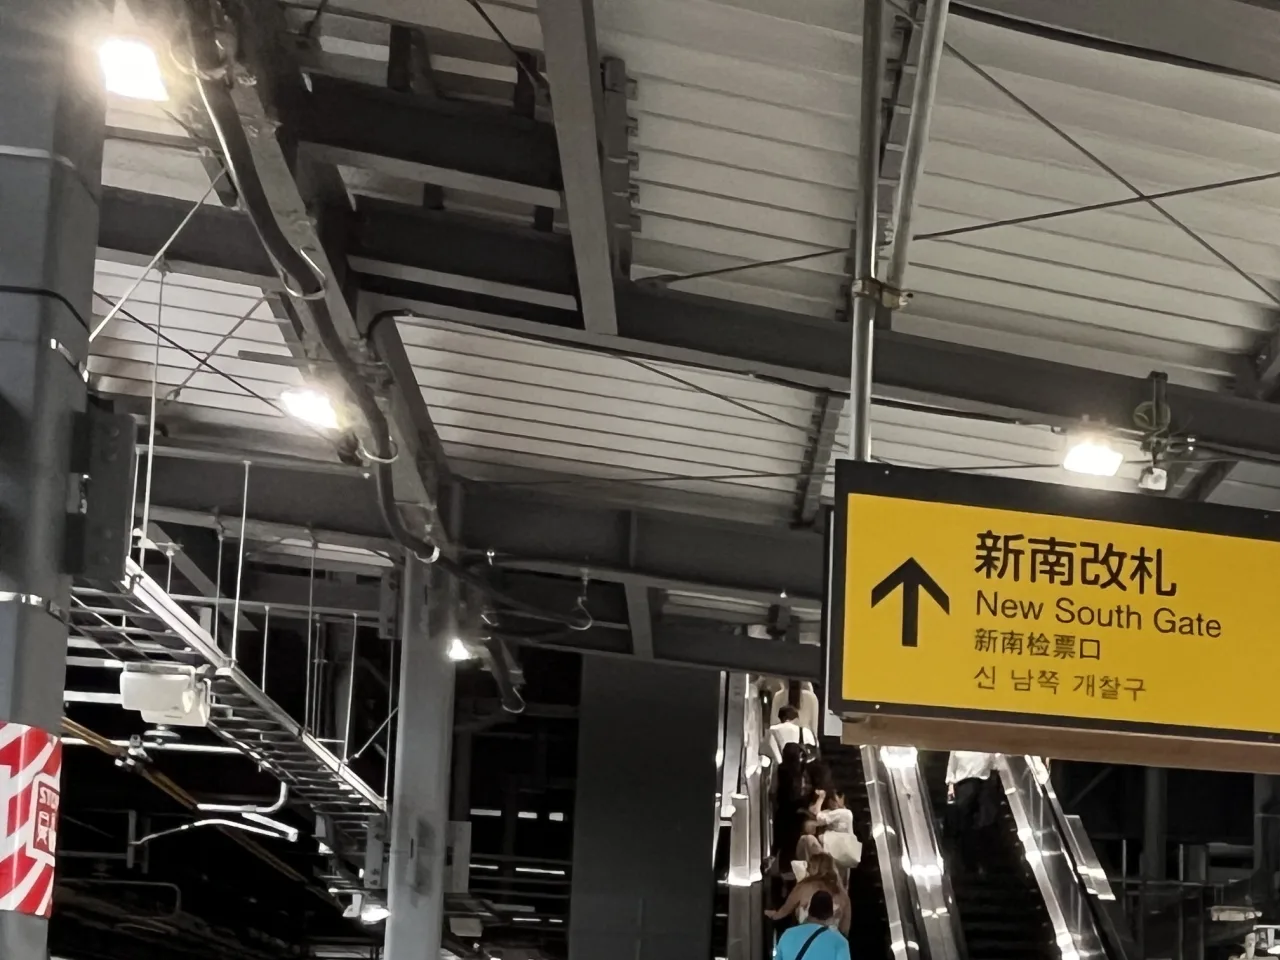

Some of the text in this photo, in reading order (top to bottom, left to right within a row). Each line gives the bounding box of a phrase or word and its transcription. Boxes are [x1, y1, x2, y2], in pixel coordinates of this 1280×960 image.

[974, 529, 1178, 597] 新南改札
[976, 590, 1222, 638] New South Gate
[974, 628, 1101, 661] 新南检票口
[974, 665, 1147, 701] 신 남쪽 개찰구
